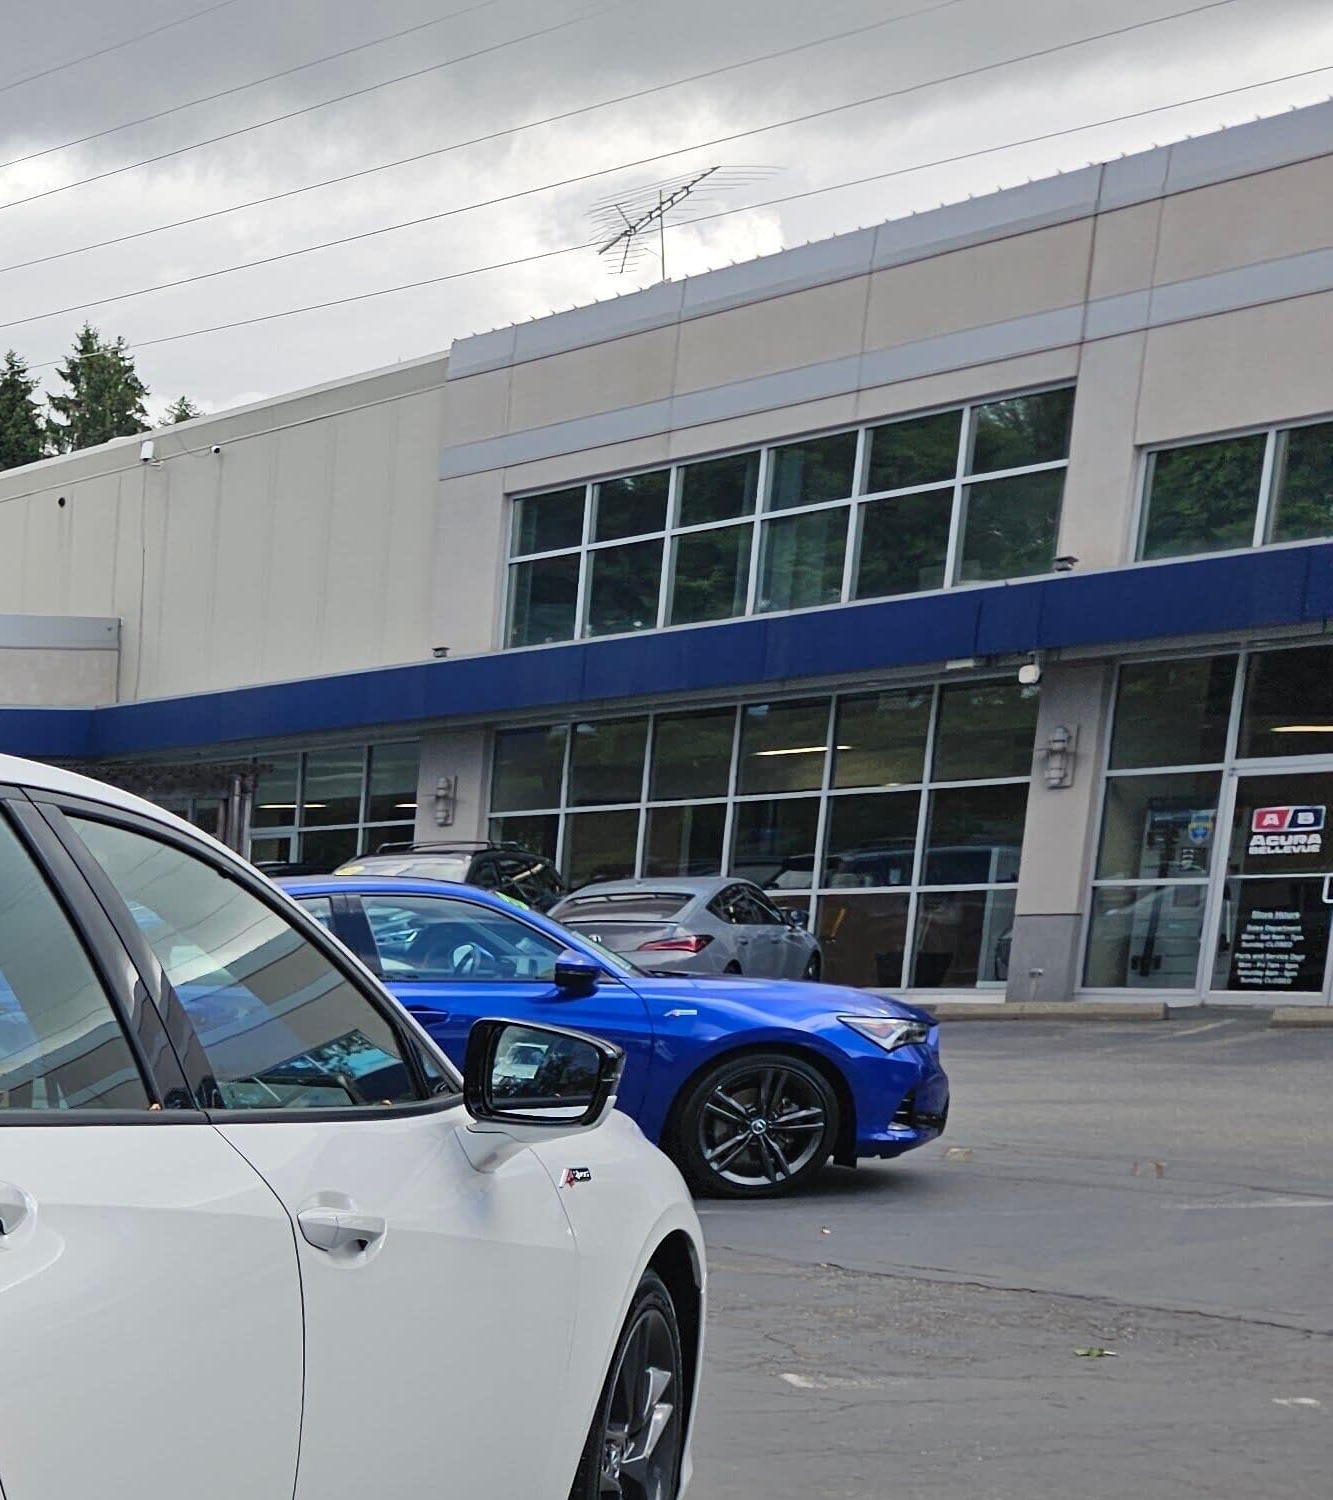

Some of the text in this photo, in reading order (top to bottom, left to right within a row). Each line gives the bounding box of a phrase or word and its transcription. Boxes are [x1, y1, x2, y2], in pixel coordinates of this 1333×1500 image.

[1262, 811, 1315, 827] A B
[1249, 833, 1323, 847] ACURA
[1248, 844, 1321, 855] BELLEVUE
